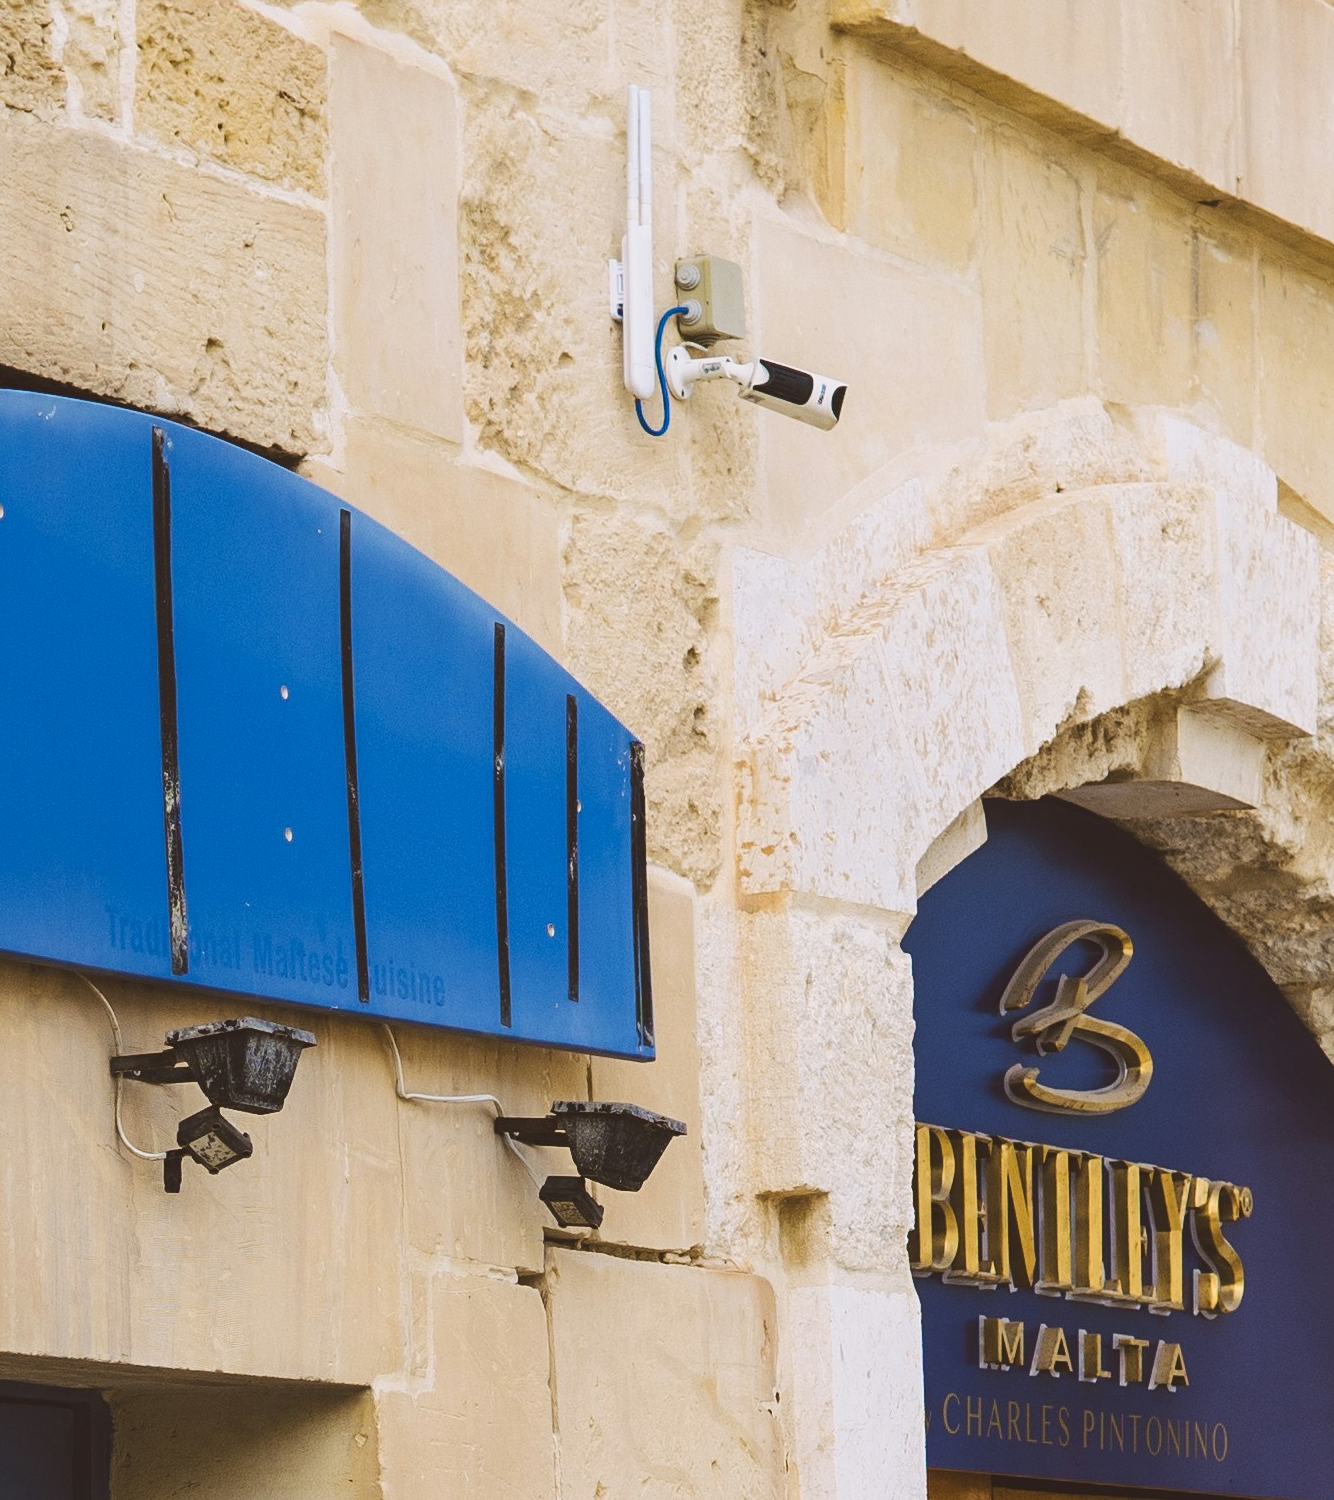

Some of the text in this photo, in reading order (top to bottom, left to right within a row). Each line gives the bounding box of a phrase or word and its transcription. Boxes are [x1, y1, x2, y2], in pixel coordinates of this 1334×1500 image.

[105, 903, 241, 970] Tradional
[370, 959, 446, 1007] uisine
[980, 1316, 1190, 1391] MALTA
[942, 1392, 1070, 1447] CHARLES
[1082, 1409, 1228, 1462] PINTONINO
